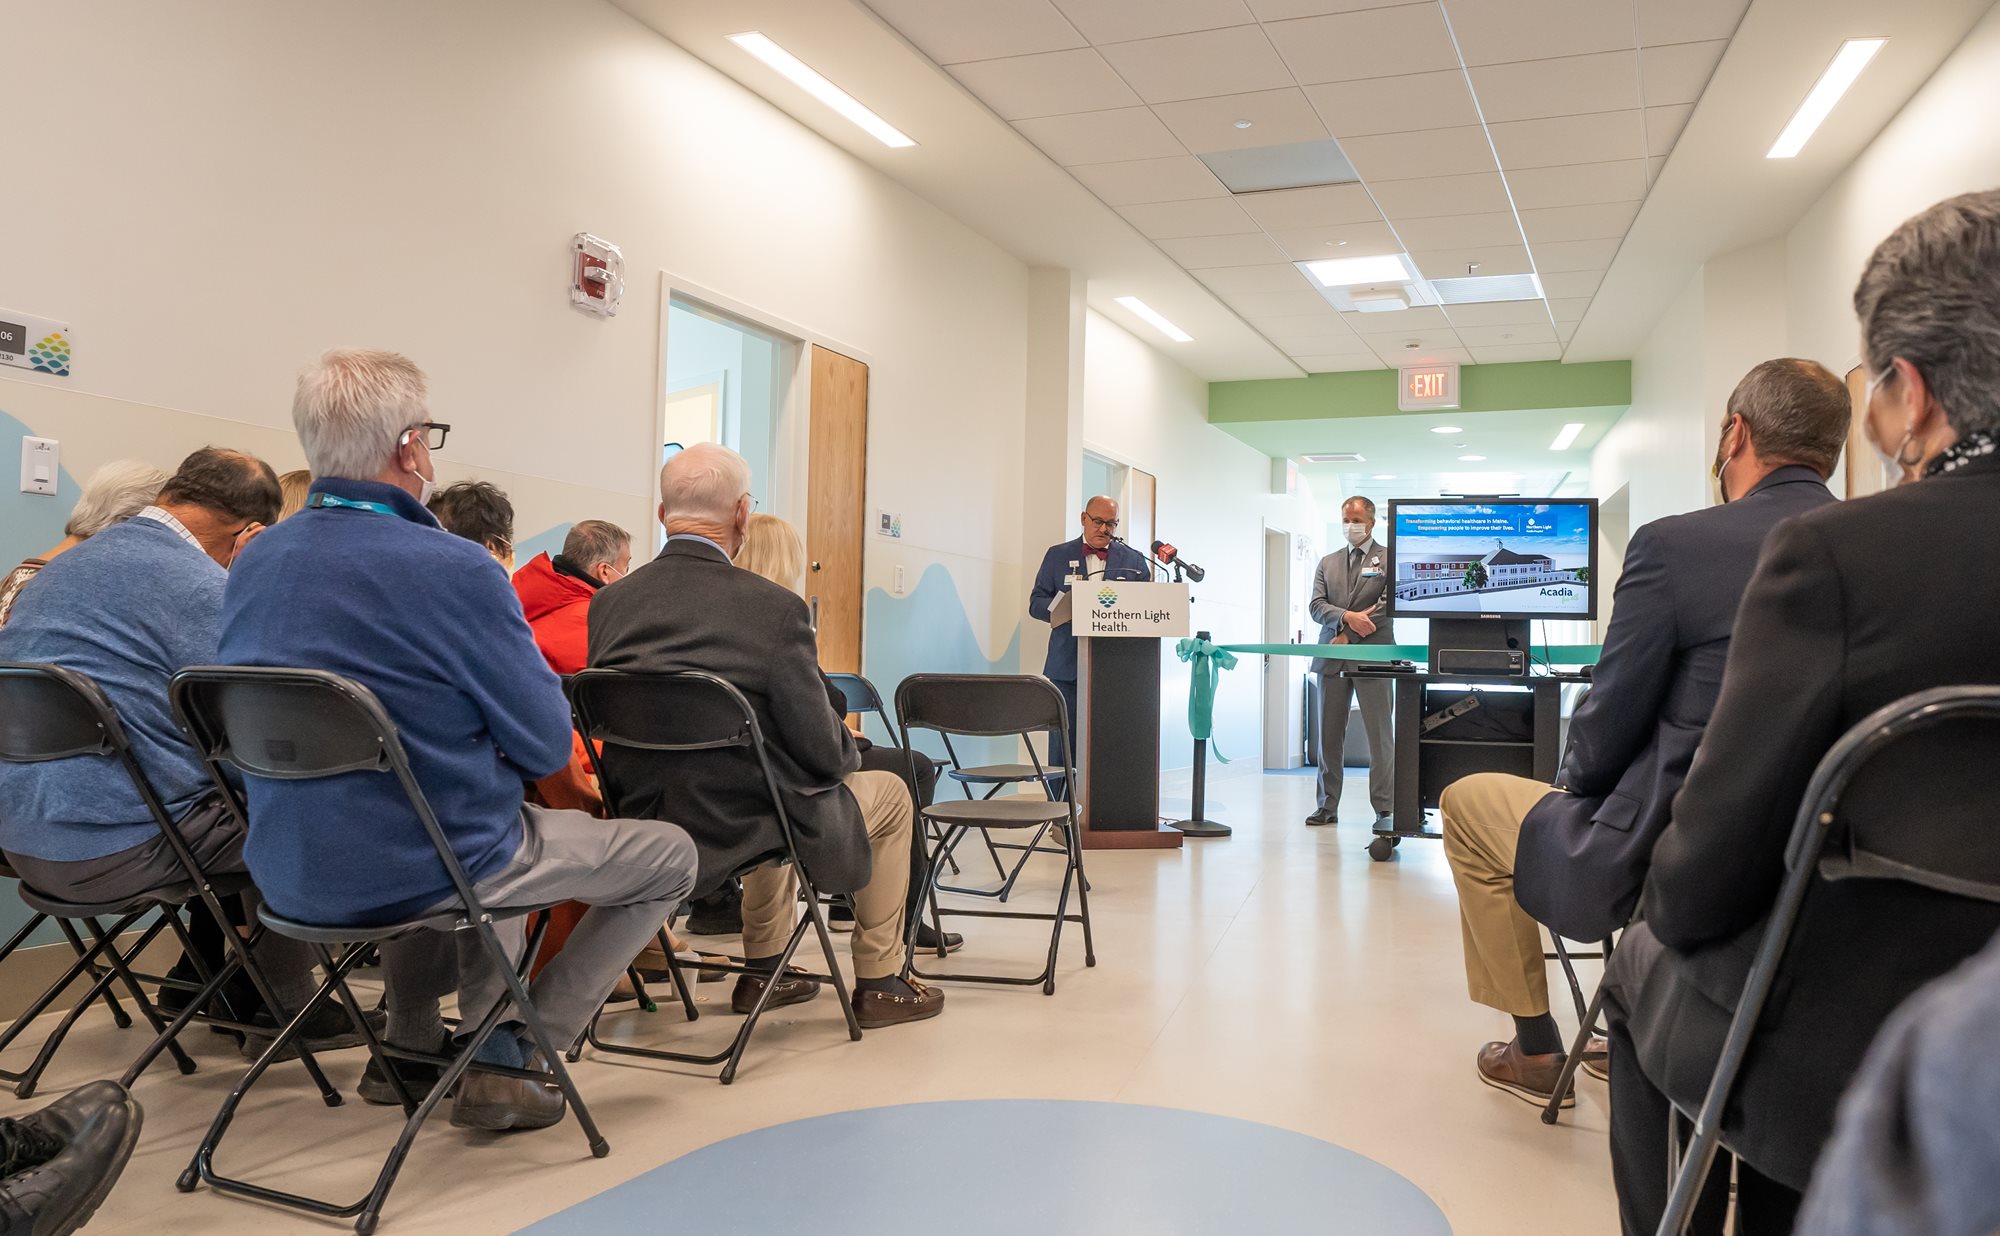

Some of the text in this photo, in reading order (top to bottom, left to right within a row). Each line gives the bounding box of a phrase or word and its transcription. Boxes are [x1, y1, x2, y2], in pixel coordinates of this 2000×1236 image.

[1414, 373, 1445, 397] EXIT
[1539, 587, 1573, 597] Acadia
[1092, 609, 1171, 623] Northern Light
[1092, 621, 1128, 632] Health
